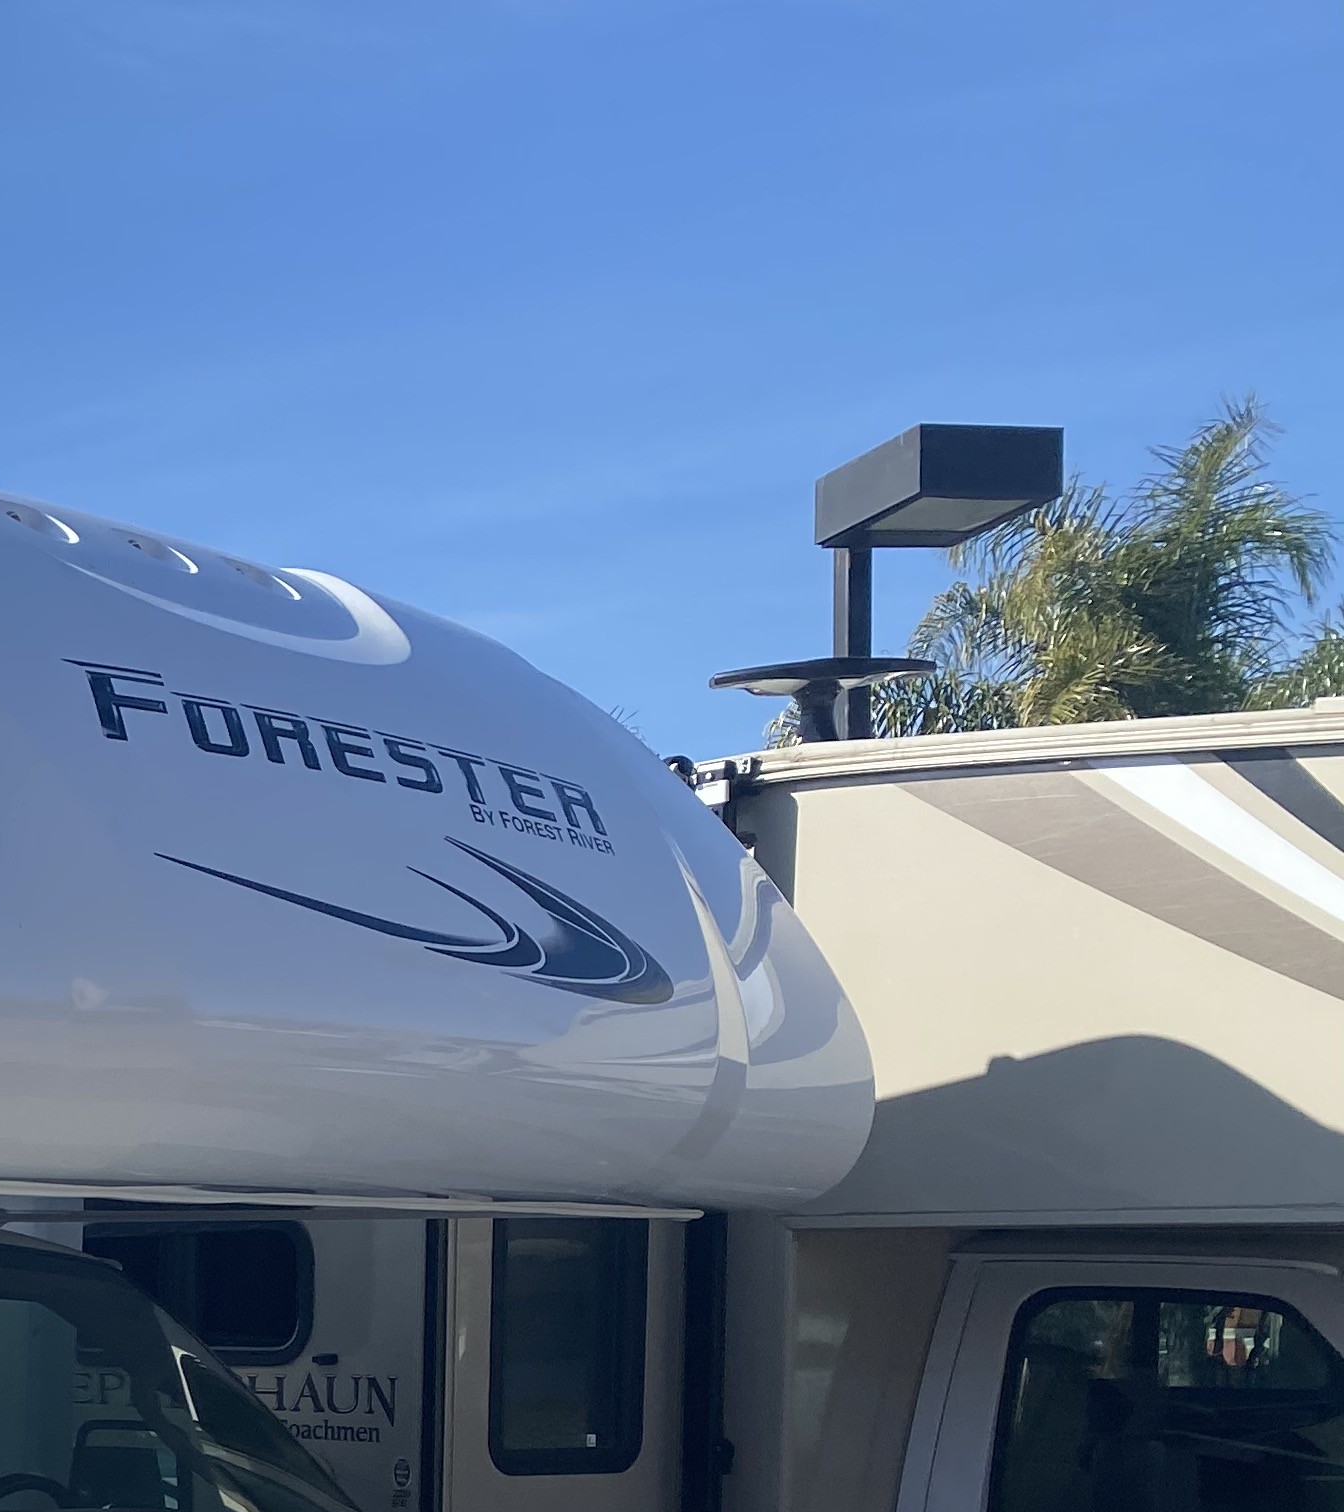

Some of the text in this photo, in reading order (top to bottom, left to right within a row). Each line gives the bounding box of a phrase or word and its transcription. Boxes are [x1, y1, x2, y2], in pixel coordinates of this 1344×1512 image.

[61, 657, 608, 836] FORESTER
[469, 804, 616, 857] BY FOREST RIVER
